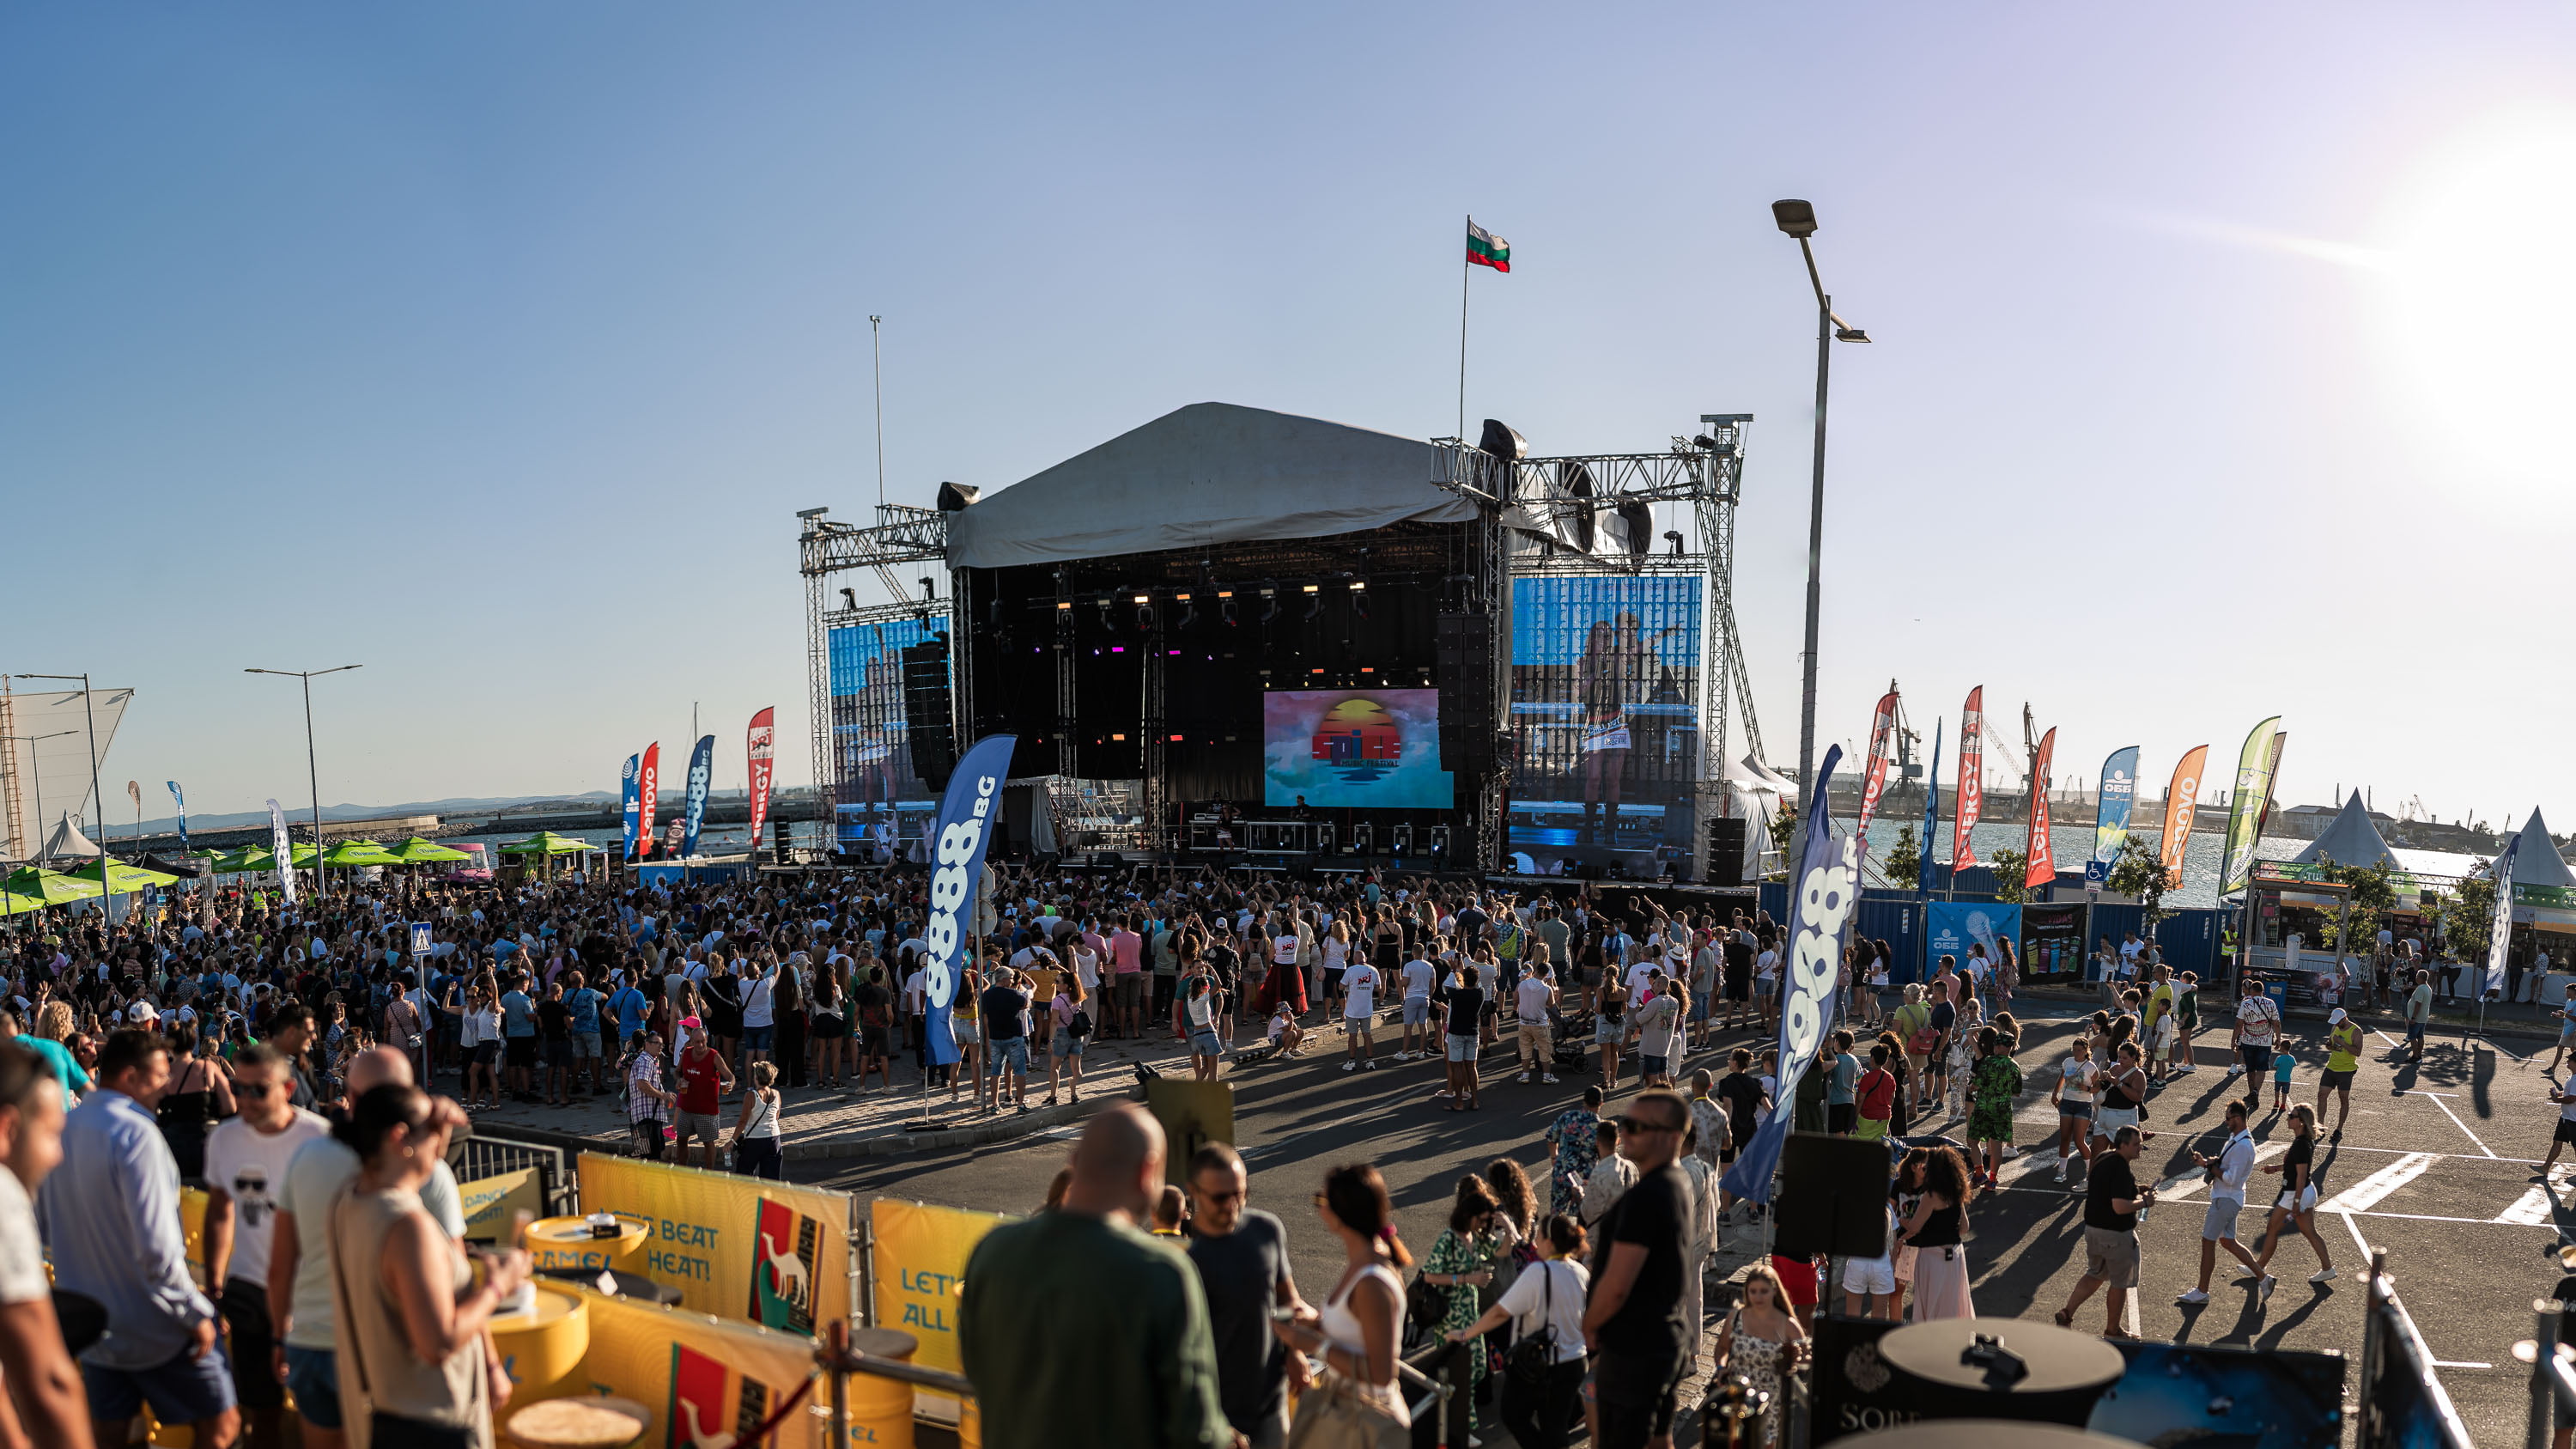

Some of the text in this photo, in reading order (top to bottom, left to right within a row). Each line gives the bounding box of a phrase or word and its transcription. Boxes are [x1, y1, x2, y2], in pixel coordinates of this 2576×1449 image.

[642, 767, 655, 841] enovo
[753, 764, 769, 838] ENERGY
[145, 886, 153, 900] P
[927, 775, 995, 1008] 8888.BG
[1933, 941, 1959, 950] ОББ
[661, 1219, 719, 1249] BEAT
[647, 1248, 711, 1282] HEAT!
[902, 1267, 958, 1296] LET'
[902, 1303, 951, 1332] ALL
